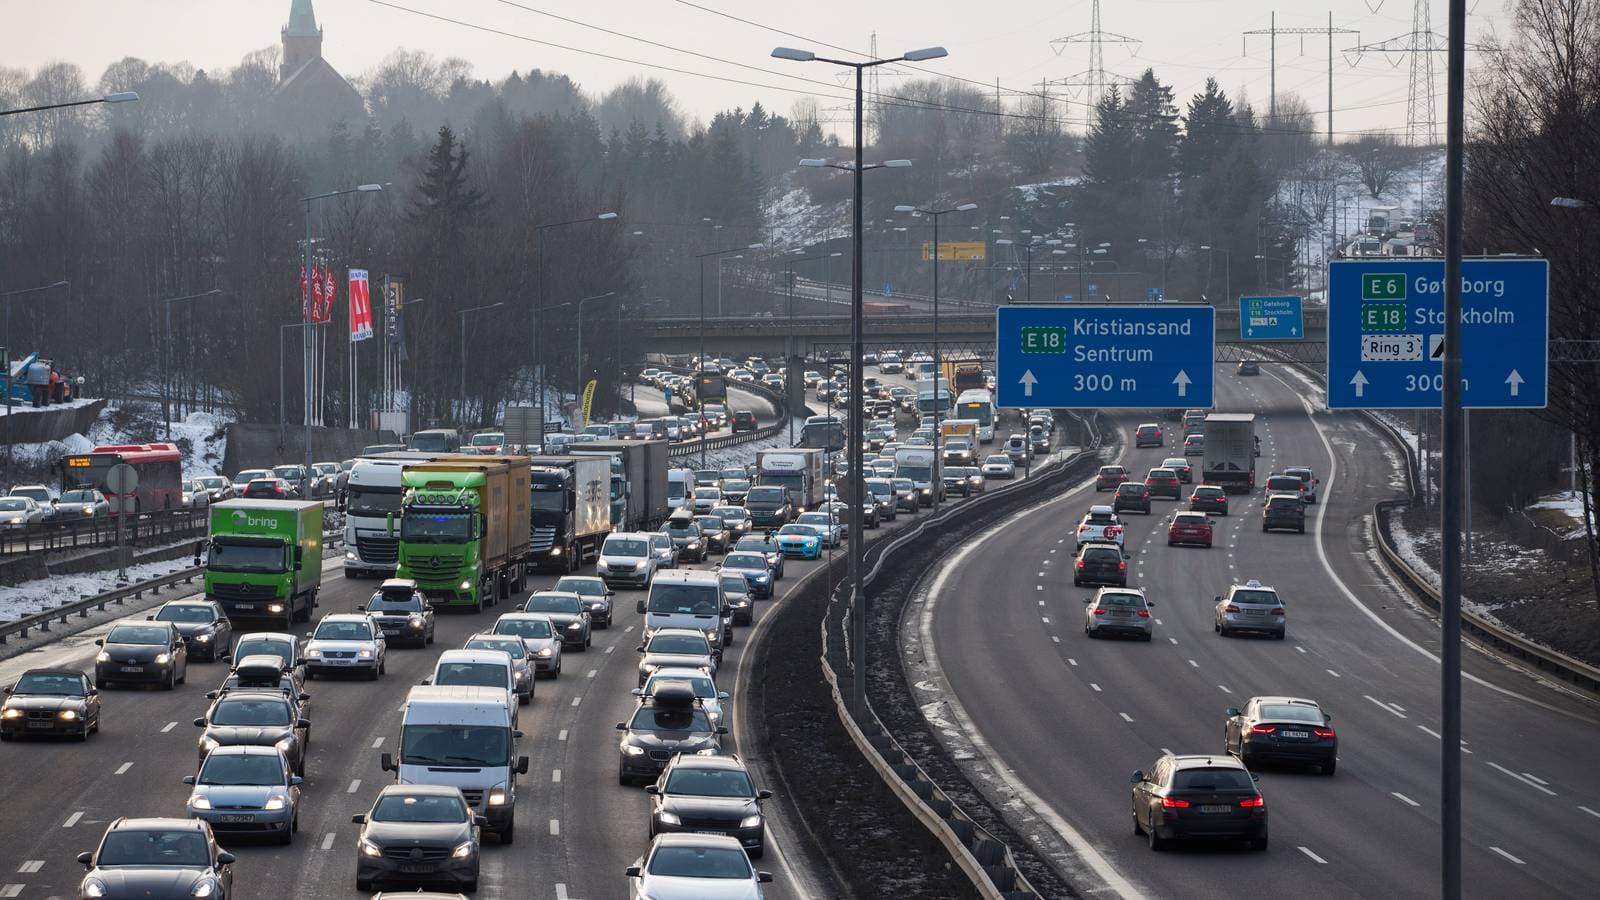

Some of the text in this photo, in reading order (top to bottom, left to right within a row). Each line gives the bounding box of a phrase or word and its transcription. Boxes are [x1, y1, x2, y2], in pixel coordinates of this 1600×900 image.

[1371, 279, 1397, 294] E 6
[1414, 276, 1505, 298] Gøtborg
[1367, 310, 1400, 325] E 18
[1415, 307, 1514, 325] Stokholm
[1073, 318, 1191, 336] Kristiansand
[1027, 332, 1060, 348] E 18
[1370, 341, 1414, 356] Ring 3
[1074, 344, 1153, 362] Sentrum
[1074, 374, 1137, 392] 300 m
[1405, 374, 1443, 392] 300
[247, 516, 278, 530] bring
